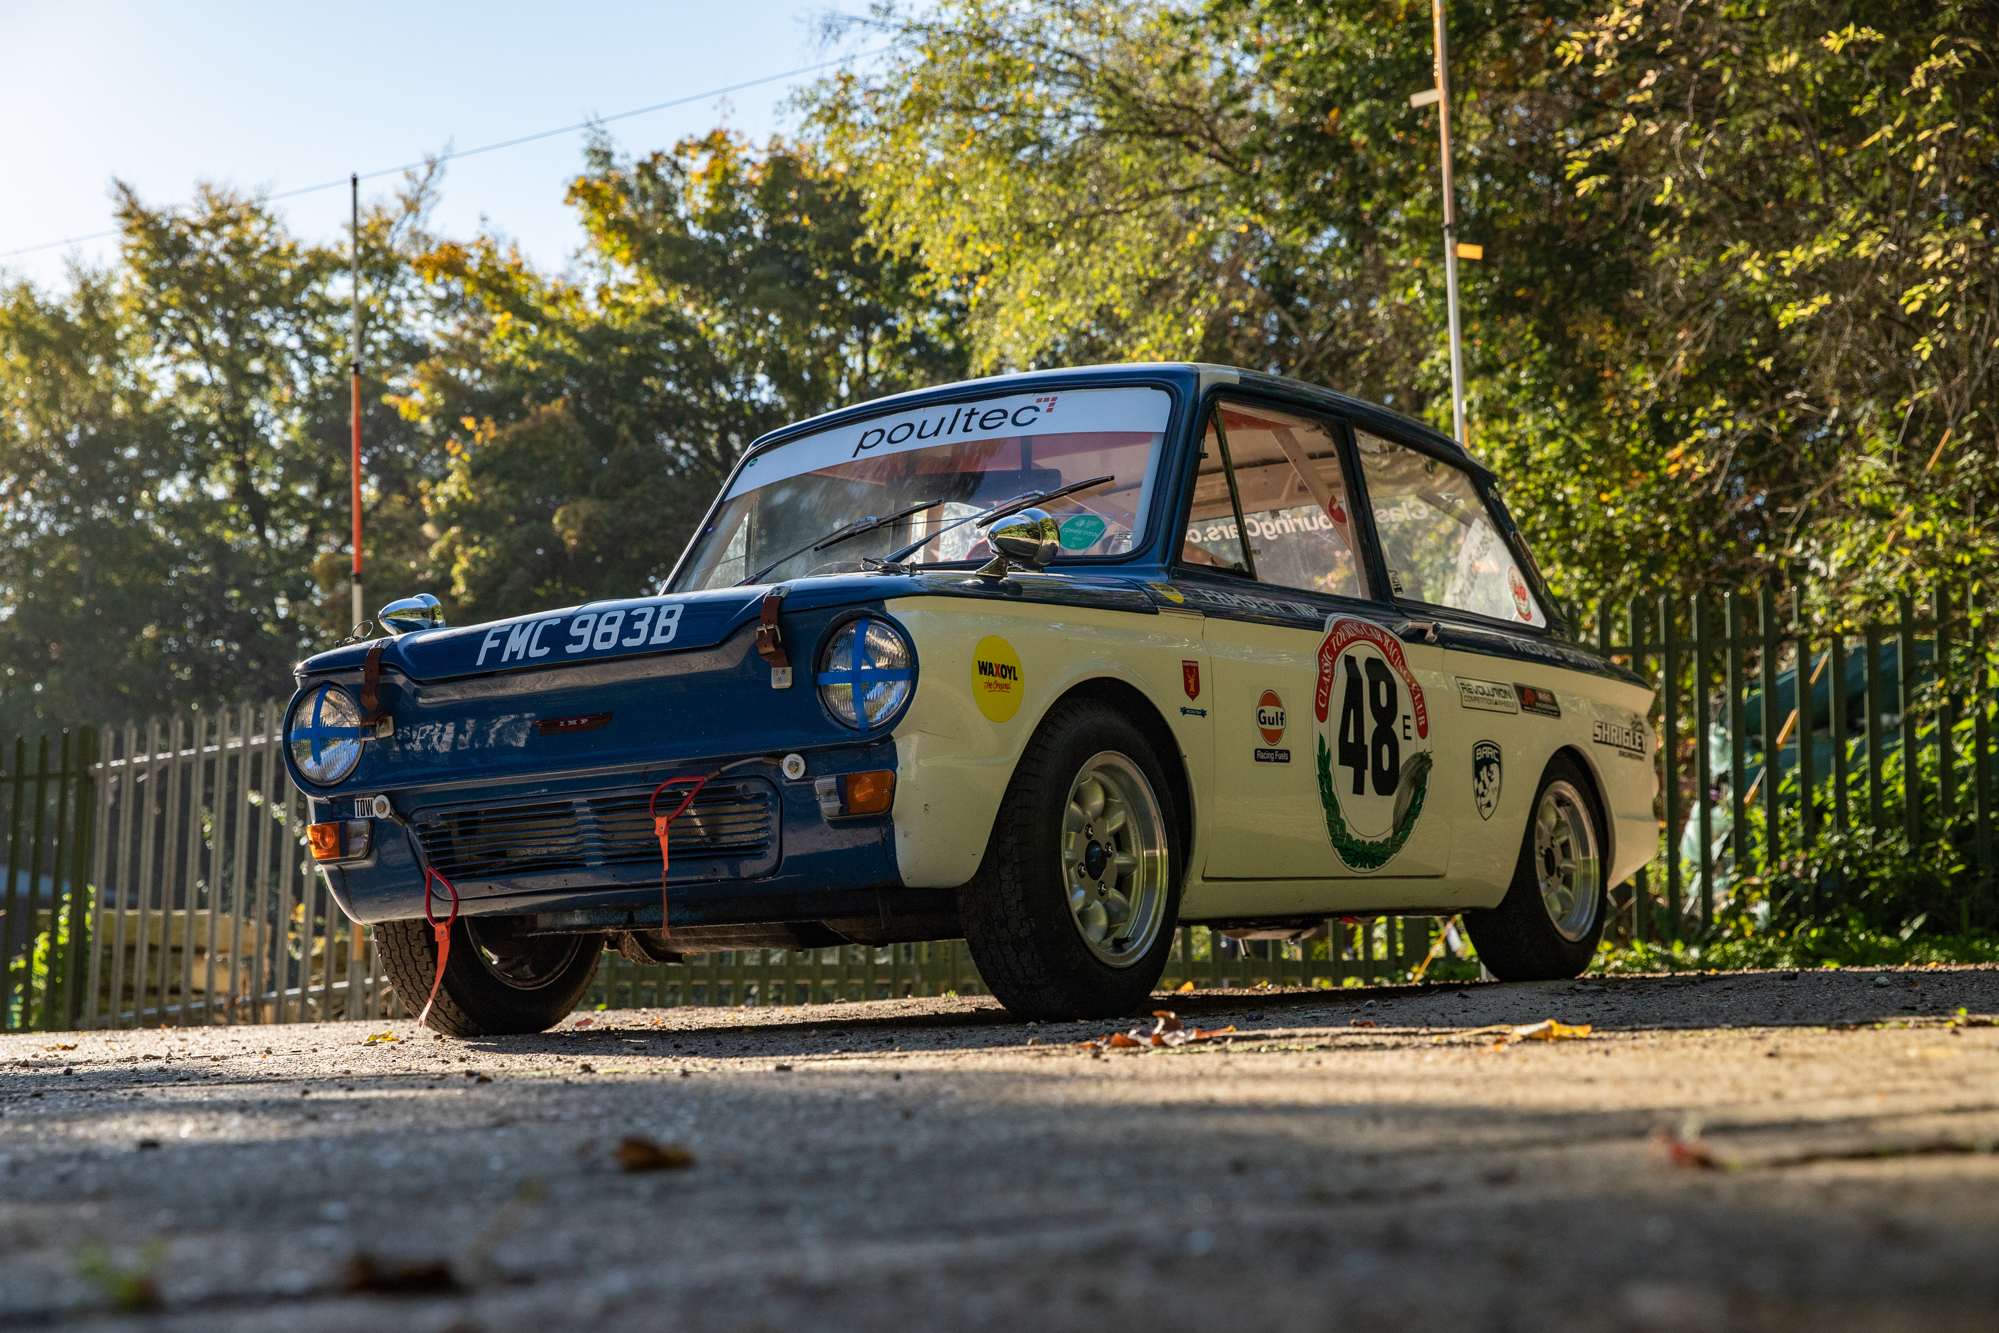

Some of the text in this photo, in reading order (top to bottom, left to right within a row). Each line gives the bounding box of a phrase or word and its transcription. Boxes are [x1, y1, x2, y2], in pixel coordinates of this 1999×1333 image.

[852, 405, 1040, 457] poultec
[1195, 588, 1295, 613] FRASER
[1292, 600, 1320, 618] IMP
[476, 604, 685, 666] FMC 983B
[977, 660, 1018, 681] WAXOYL
[1318, 622, 1426, 726] CLASSIC TOURING CAR RACING CLUB
[993, 680, 1012, 692] Original
[1460, 682, 1513, 700] REVOLUTION
[1464, 695, 1495, 705] COMPETITION
[559, 718, 588, 727] IMP
[1258, 709, 1285, 726] Gulf
[1338, 654, 1400, 796] 48
[1402, 715, 1412, 741] E
[1593, 721, 1647, 753] SHRIGLEY
[1256, 750, 1288, 761] Racing Fuels
[1475, 746, 1500, 762] BARC
[355, 798, 374, 817] TOW
